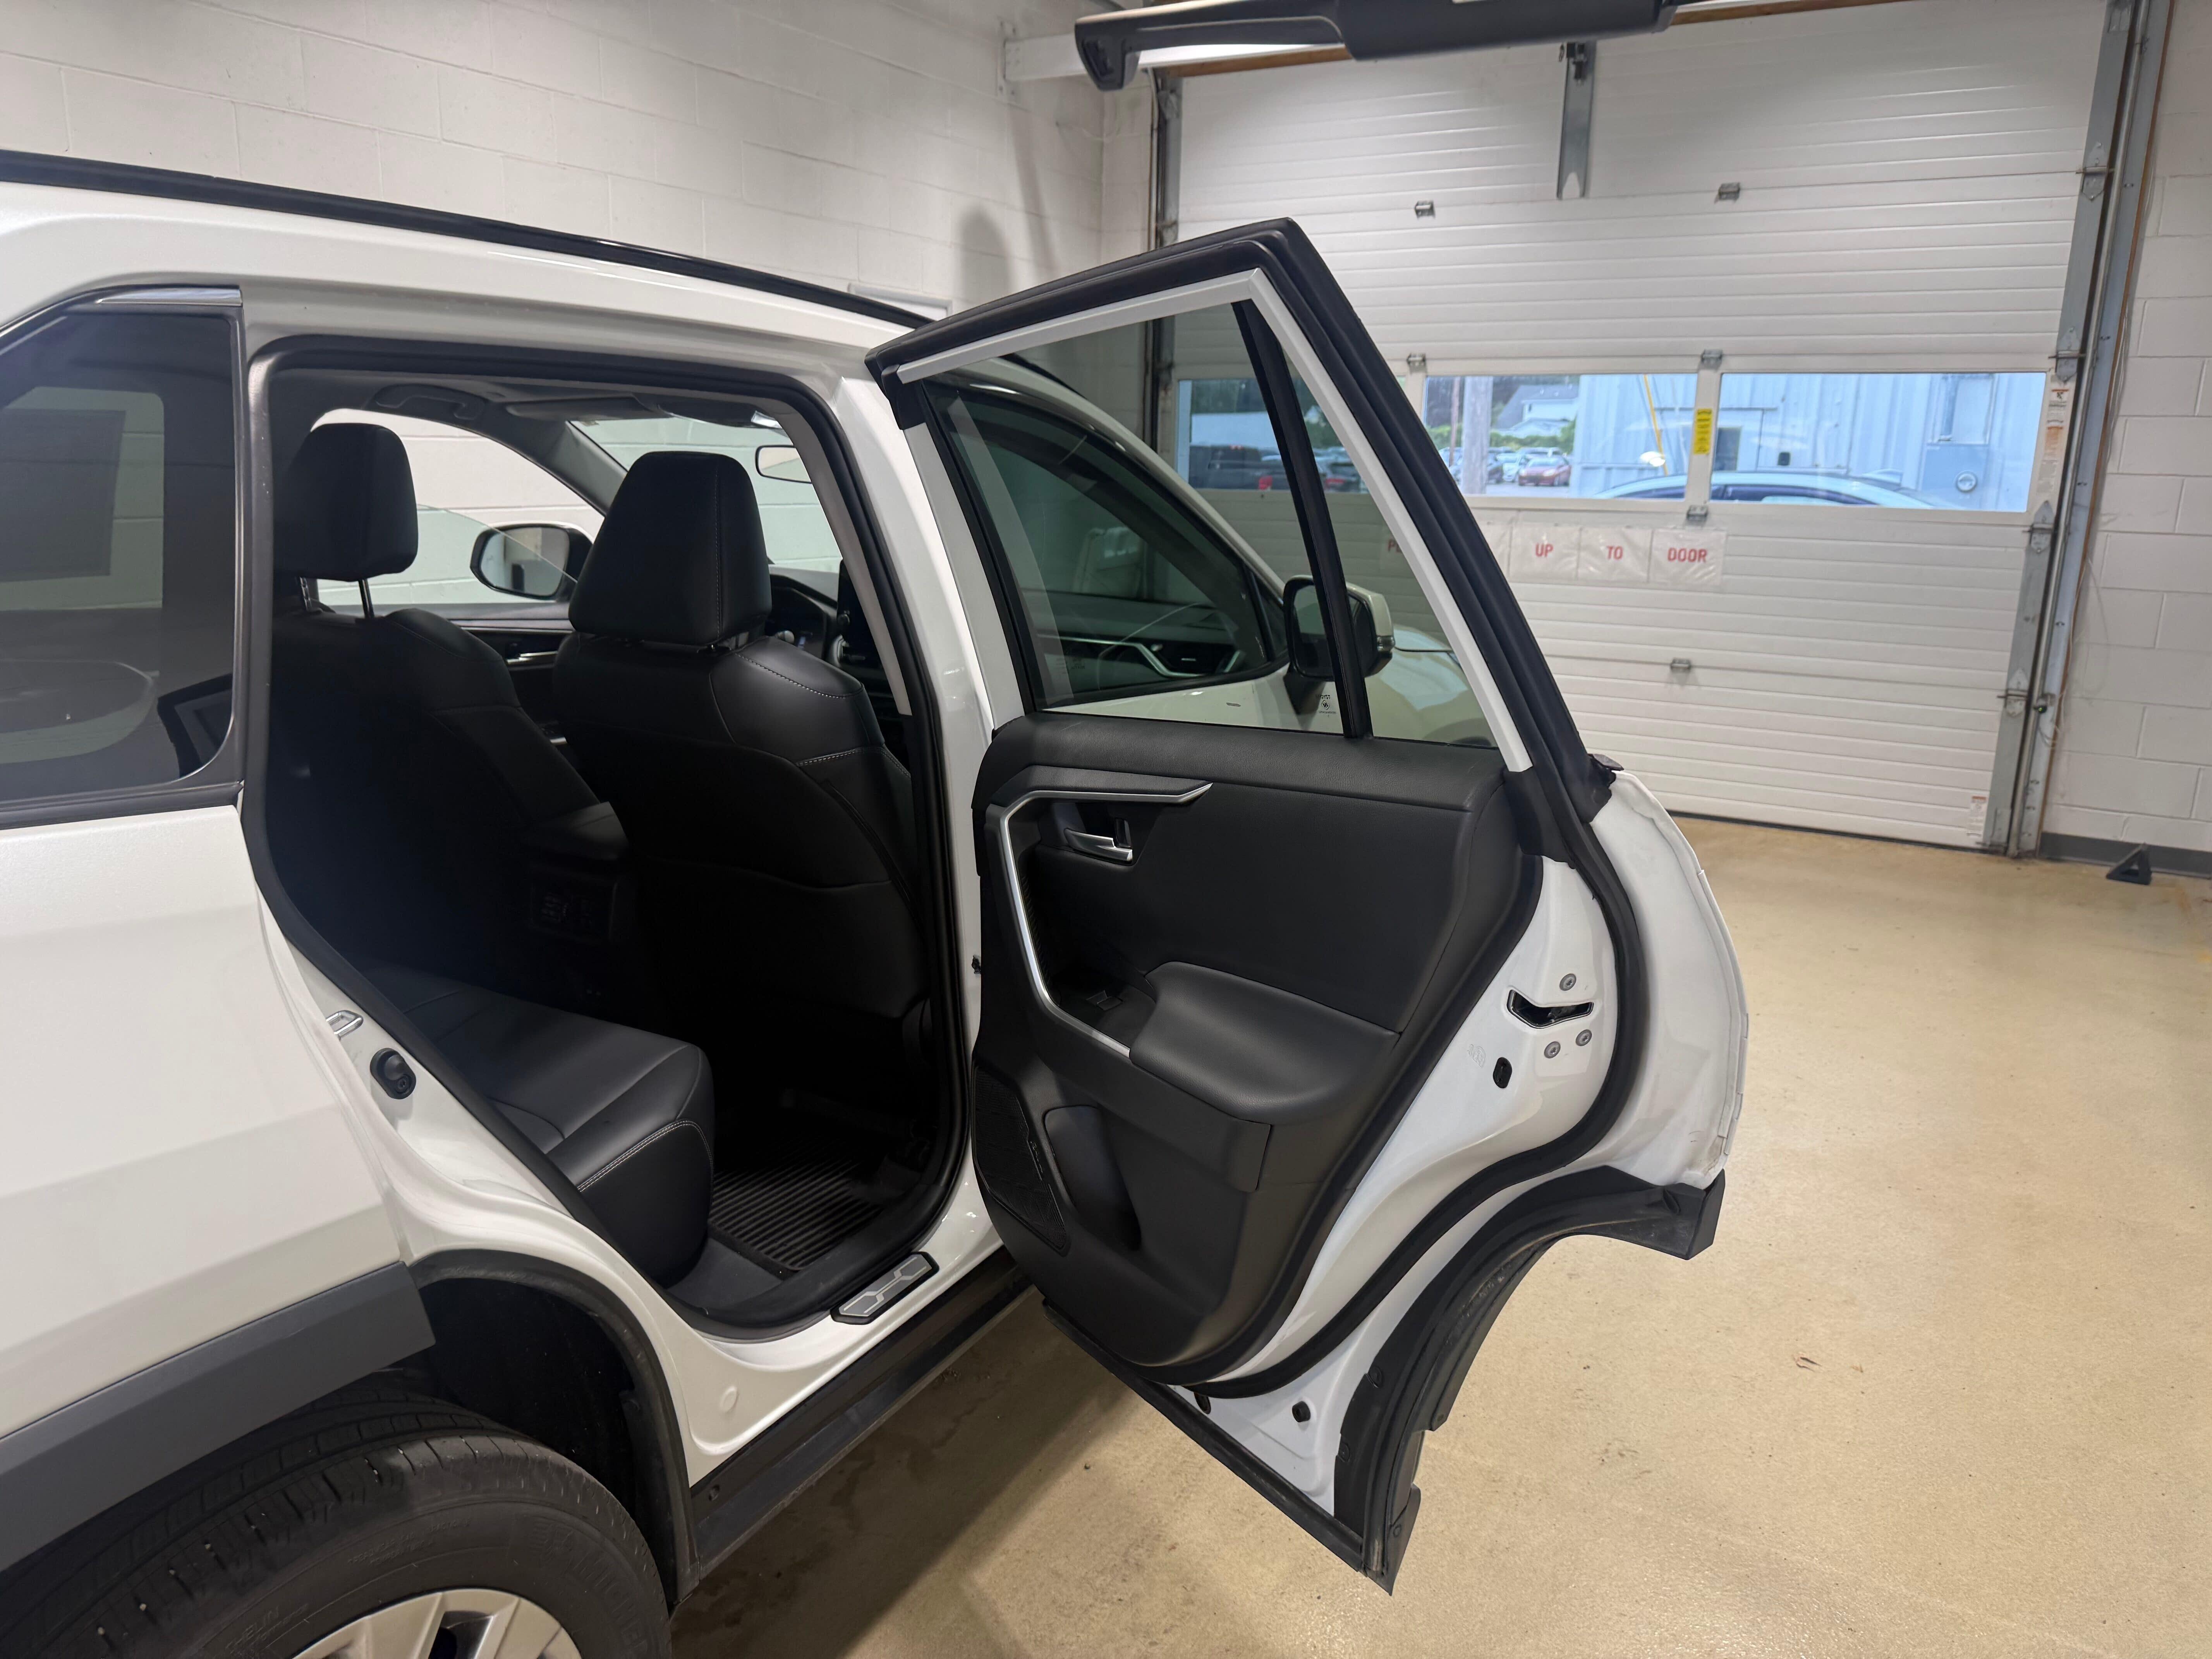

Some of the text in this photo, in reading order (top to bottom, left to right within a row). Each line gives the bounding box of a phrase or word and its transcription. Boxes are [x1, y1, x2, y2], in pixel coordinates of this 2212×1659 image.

[1535, 543, 1707, 563] UP TO DOOR
